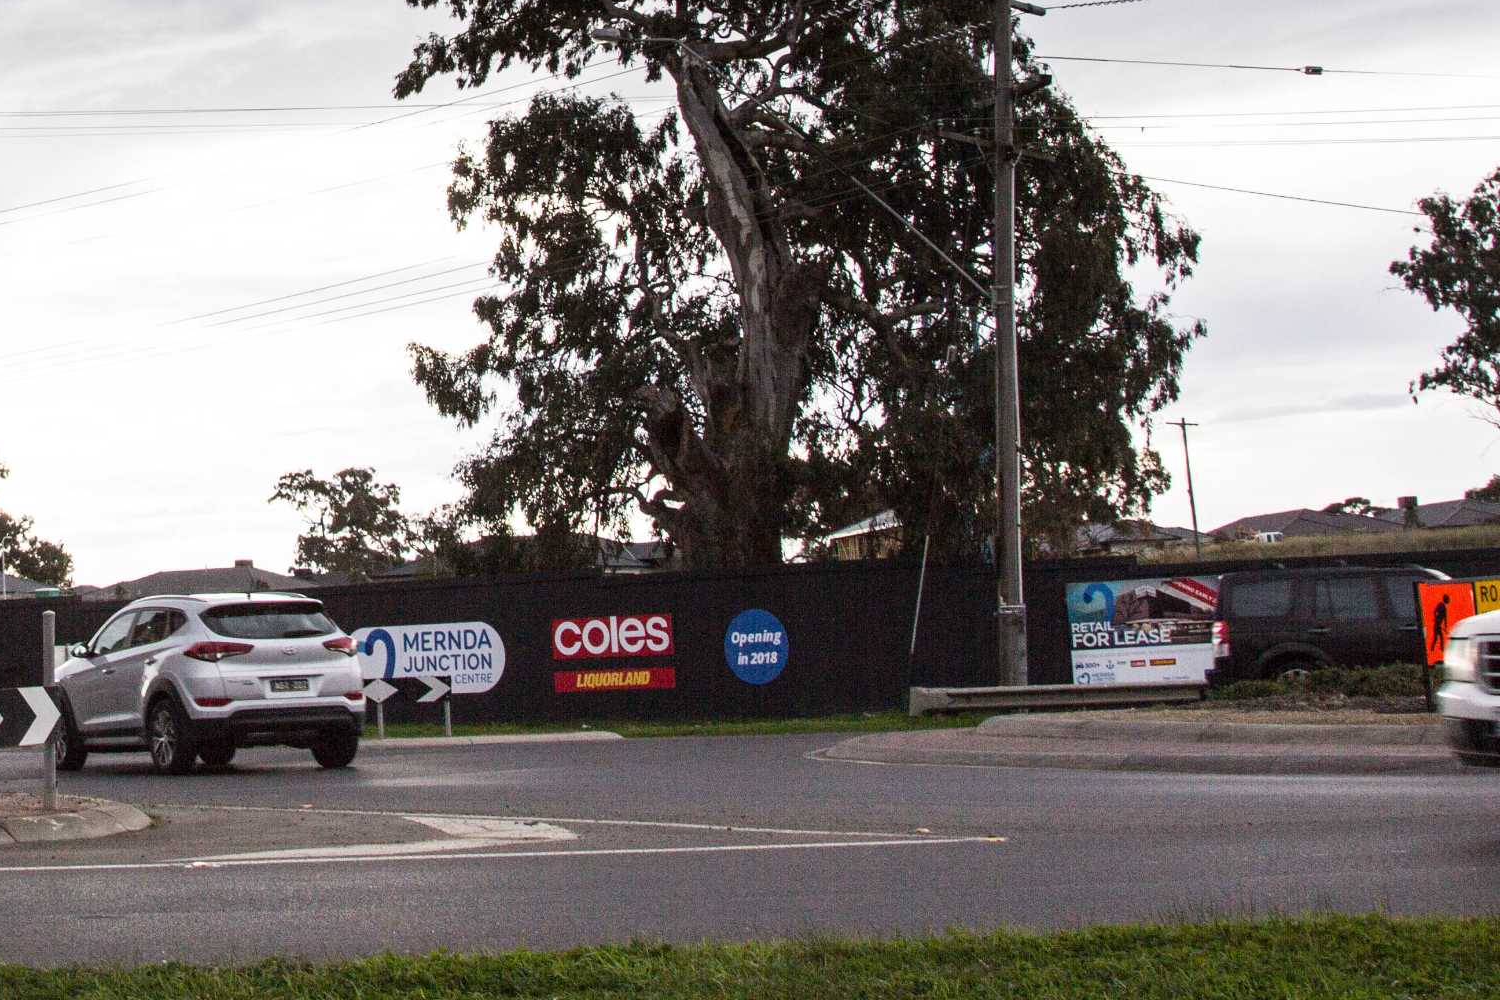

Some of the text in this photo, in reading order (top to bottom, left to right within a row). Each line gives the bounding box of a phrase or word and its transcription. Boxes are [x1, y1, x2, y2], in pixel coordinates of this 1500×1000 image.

[554, 615, 670, 656] coles
[1071, 620, 1115, 633] RETAIL
[403, 628, 492, 653] MERNDA
[731, 630, 782, 648] Opening
[1072, 628, 1172, 648] FOR LEASE
[404, 653, 492, 673] JUNCTION
[737, 651, 778, 665] in 2018
[454, 673, 493, 685] CENTRE
[576, 669, 651, 688] LIQUORLAND
